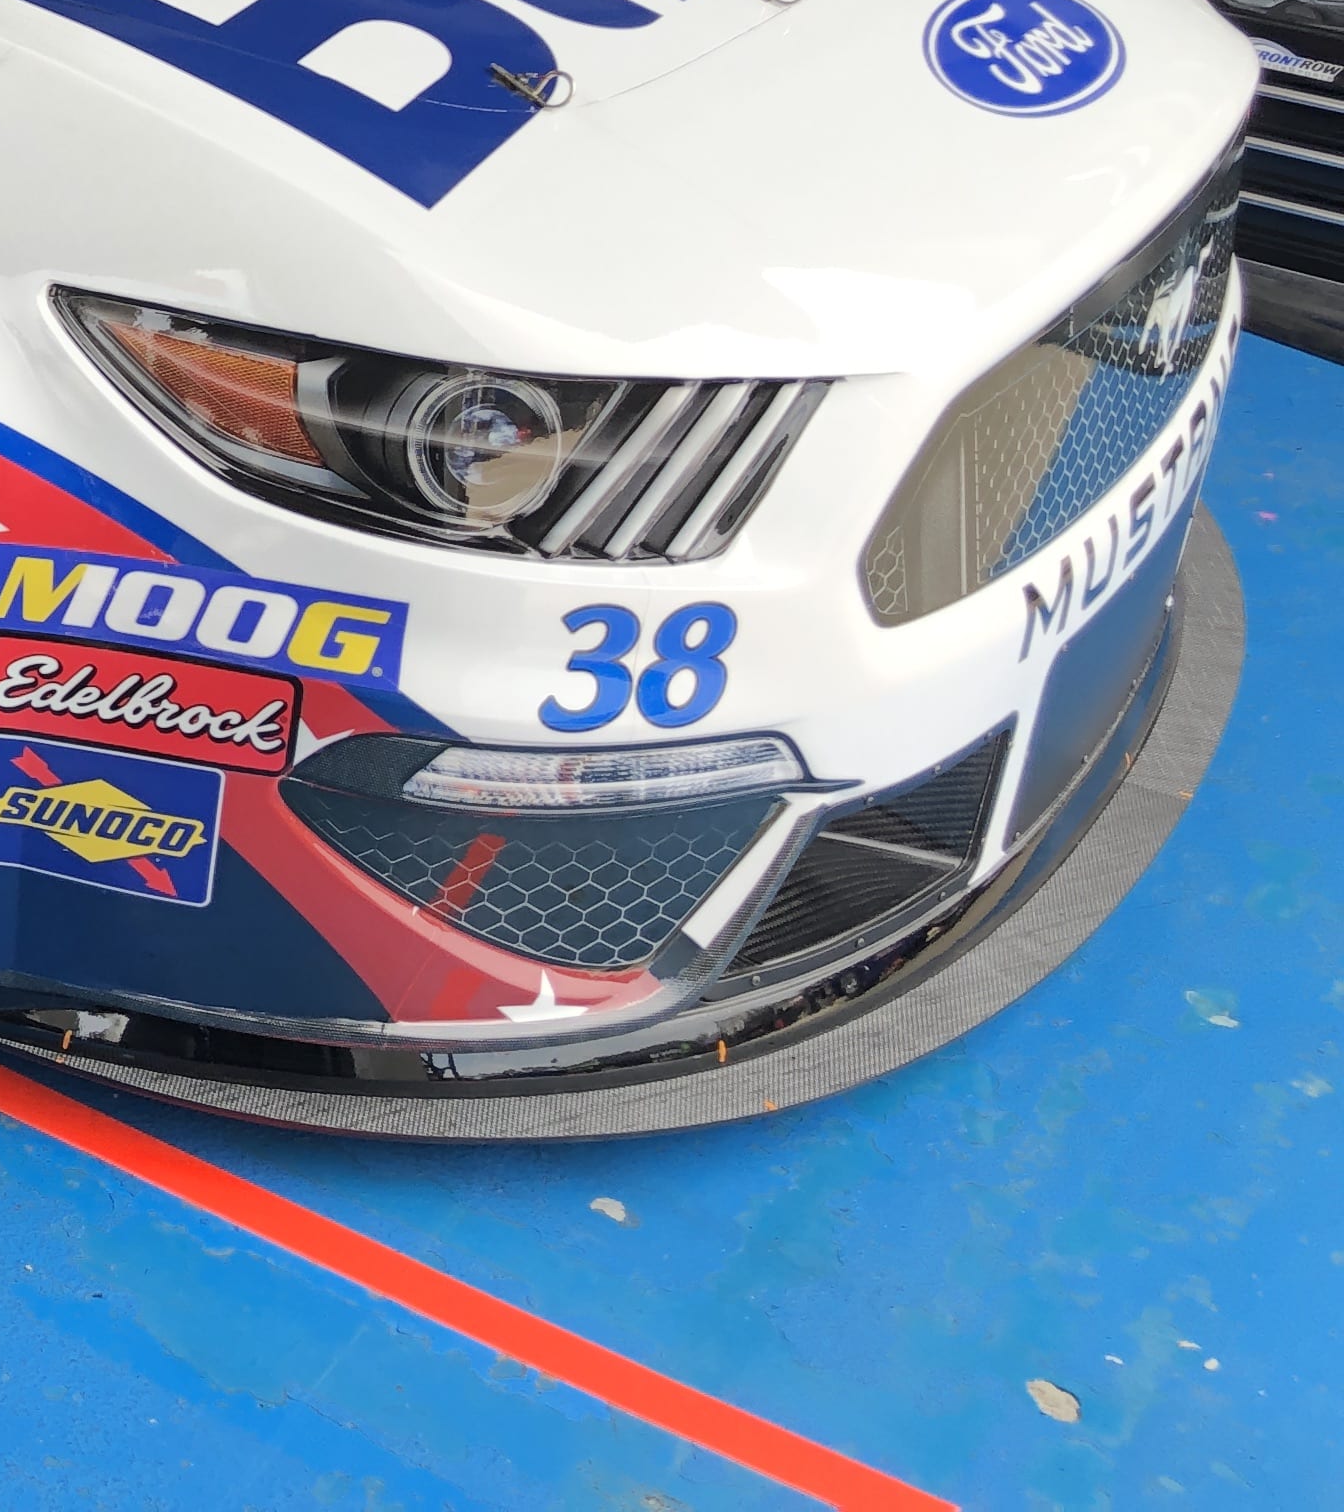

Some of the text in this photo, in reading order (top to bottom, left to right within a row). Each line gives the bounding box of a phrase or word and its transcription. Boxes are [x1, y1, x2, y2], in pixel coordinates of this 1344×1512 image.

[951, 3, 1095, 94] Ford
[1256, 49, 1342, 76] RONTROW
[538, 601, 740, 734] 38
[0, 792, 198, 853] SUNOCO
